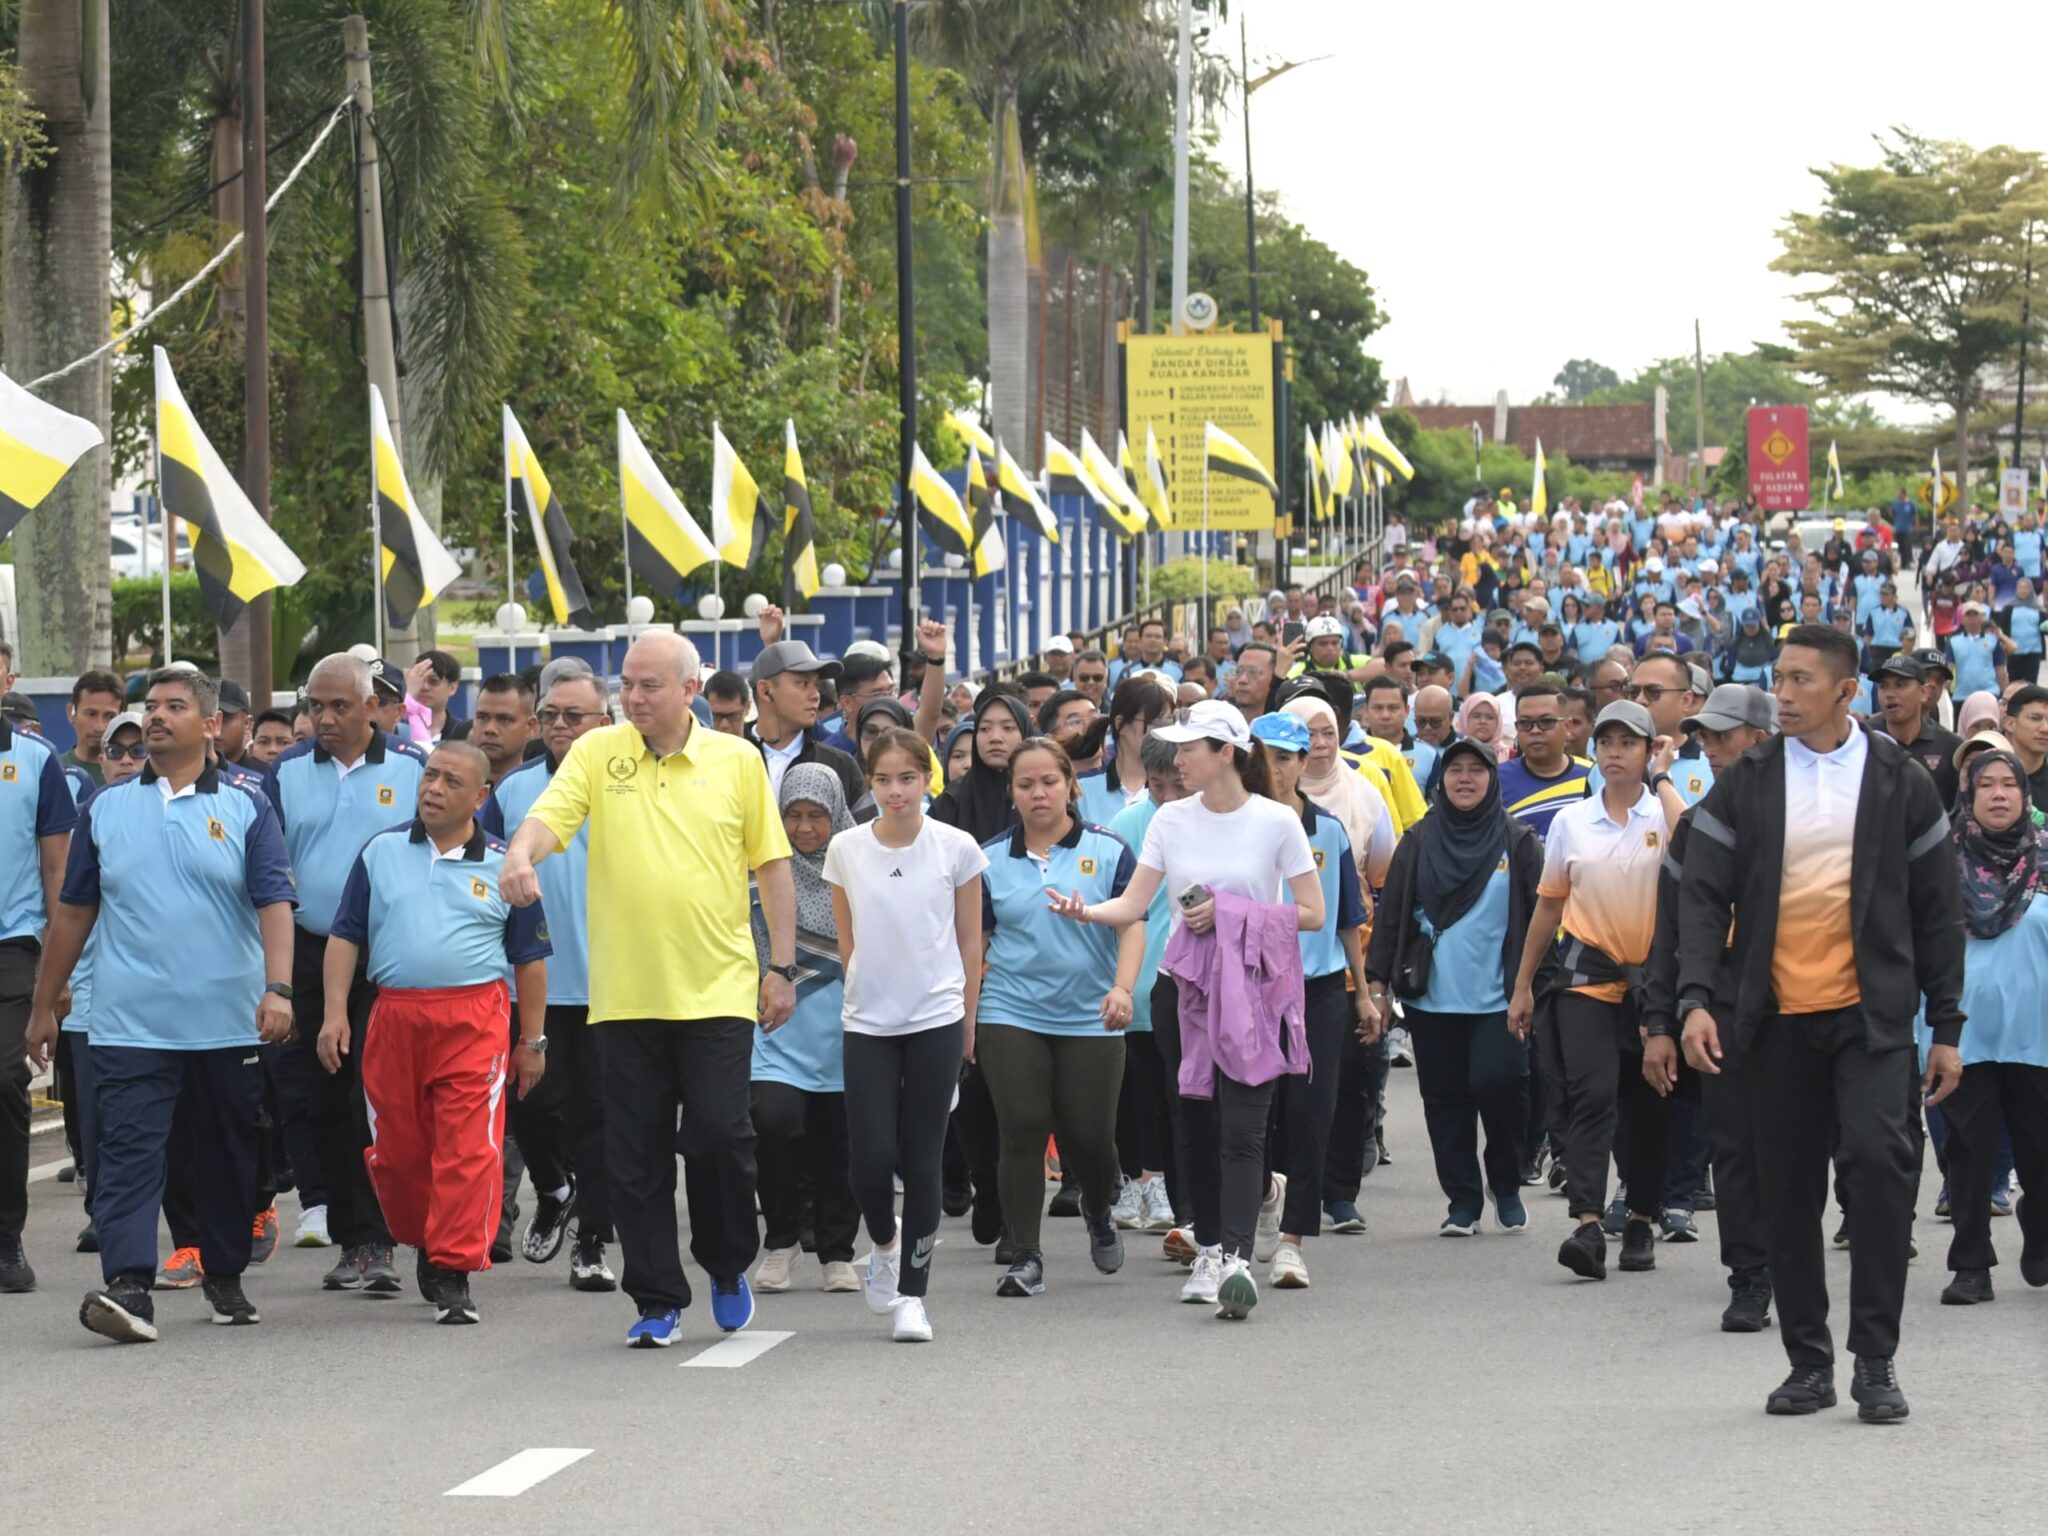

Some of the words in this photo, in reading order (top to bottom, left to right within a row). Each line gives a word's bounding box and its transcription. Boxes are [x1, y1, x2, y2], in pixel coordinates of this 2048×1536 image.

[1152, 359, 1201, 368] BANDAR
[1206, 358, 1248, 367] DIRAJA
[1149, 369, 1188, 378] KUALA
[1193, 368, 1250, 377] KANGSAR
[1210, 392, 1233, 400] SHAH
[1760, 472, 1798, 481] BULATAN
[1766, 483, 1805, 492] HADAPAN
[1785, 496, 1792, 504] M
